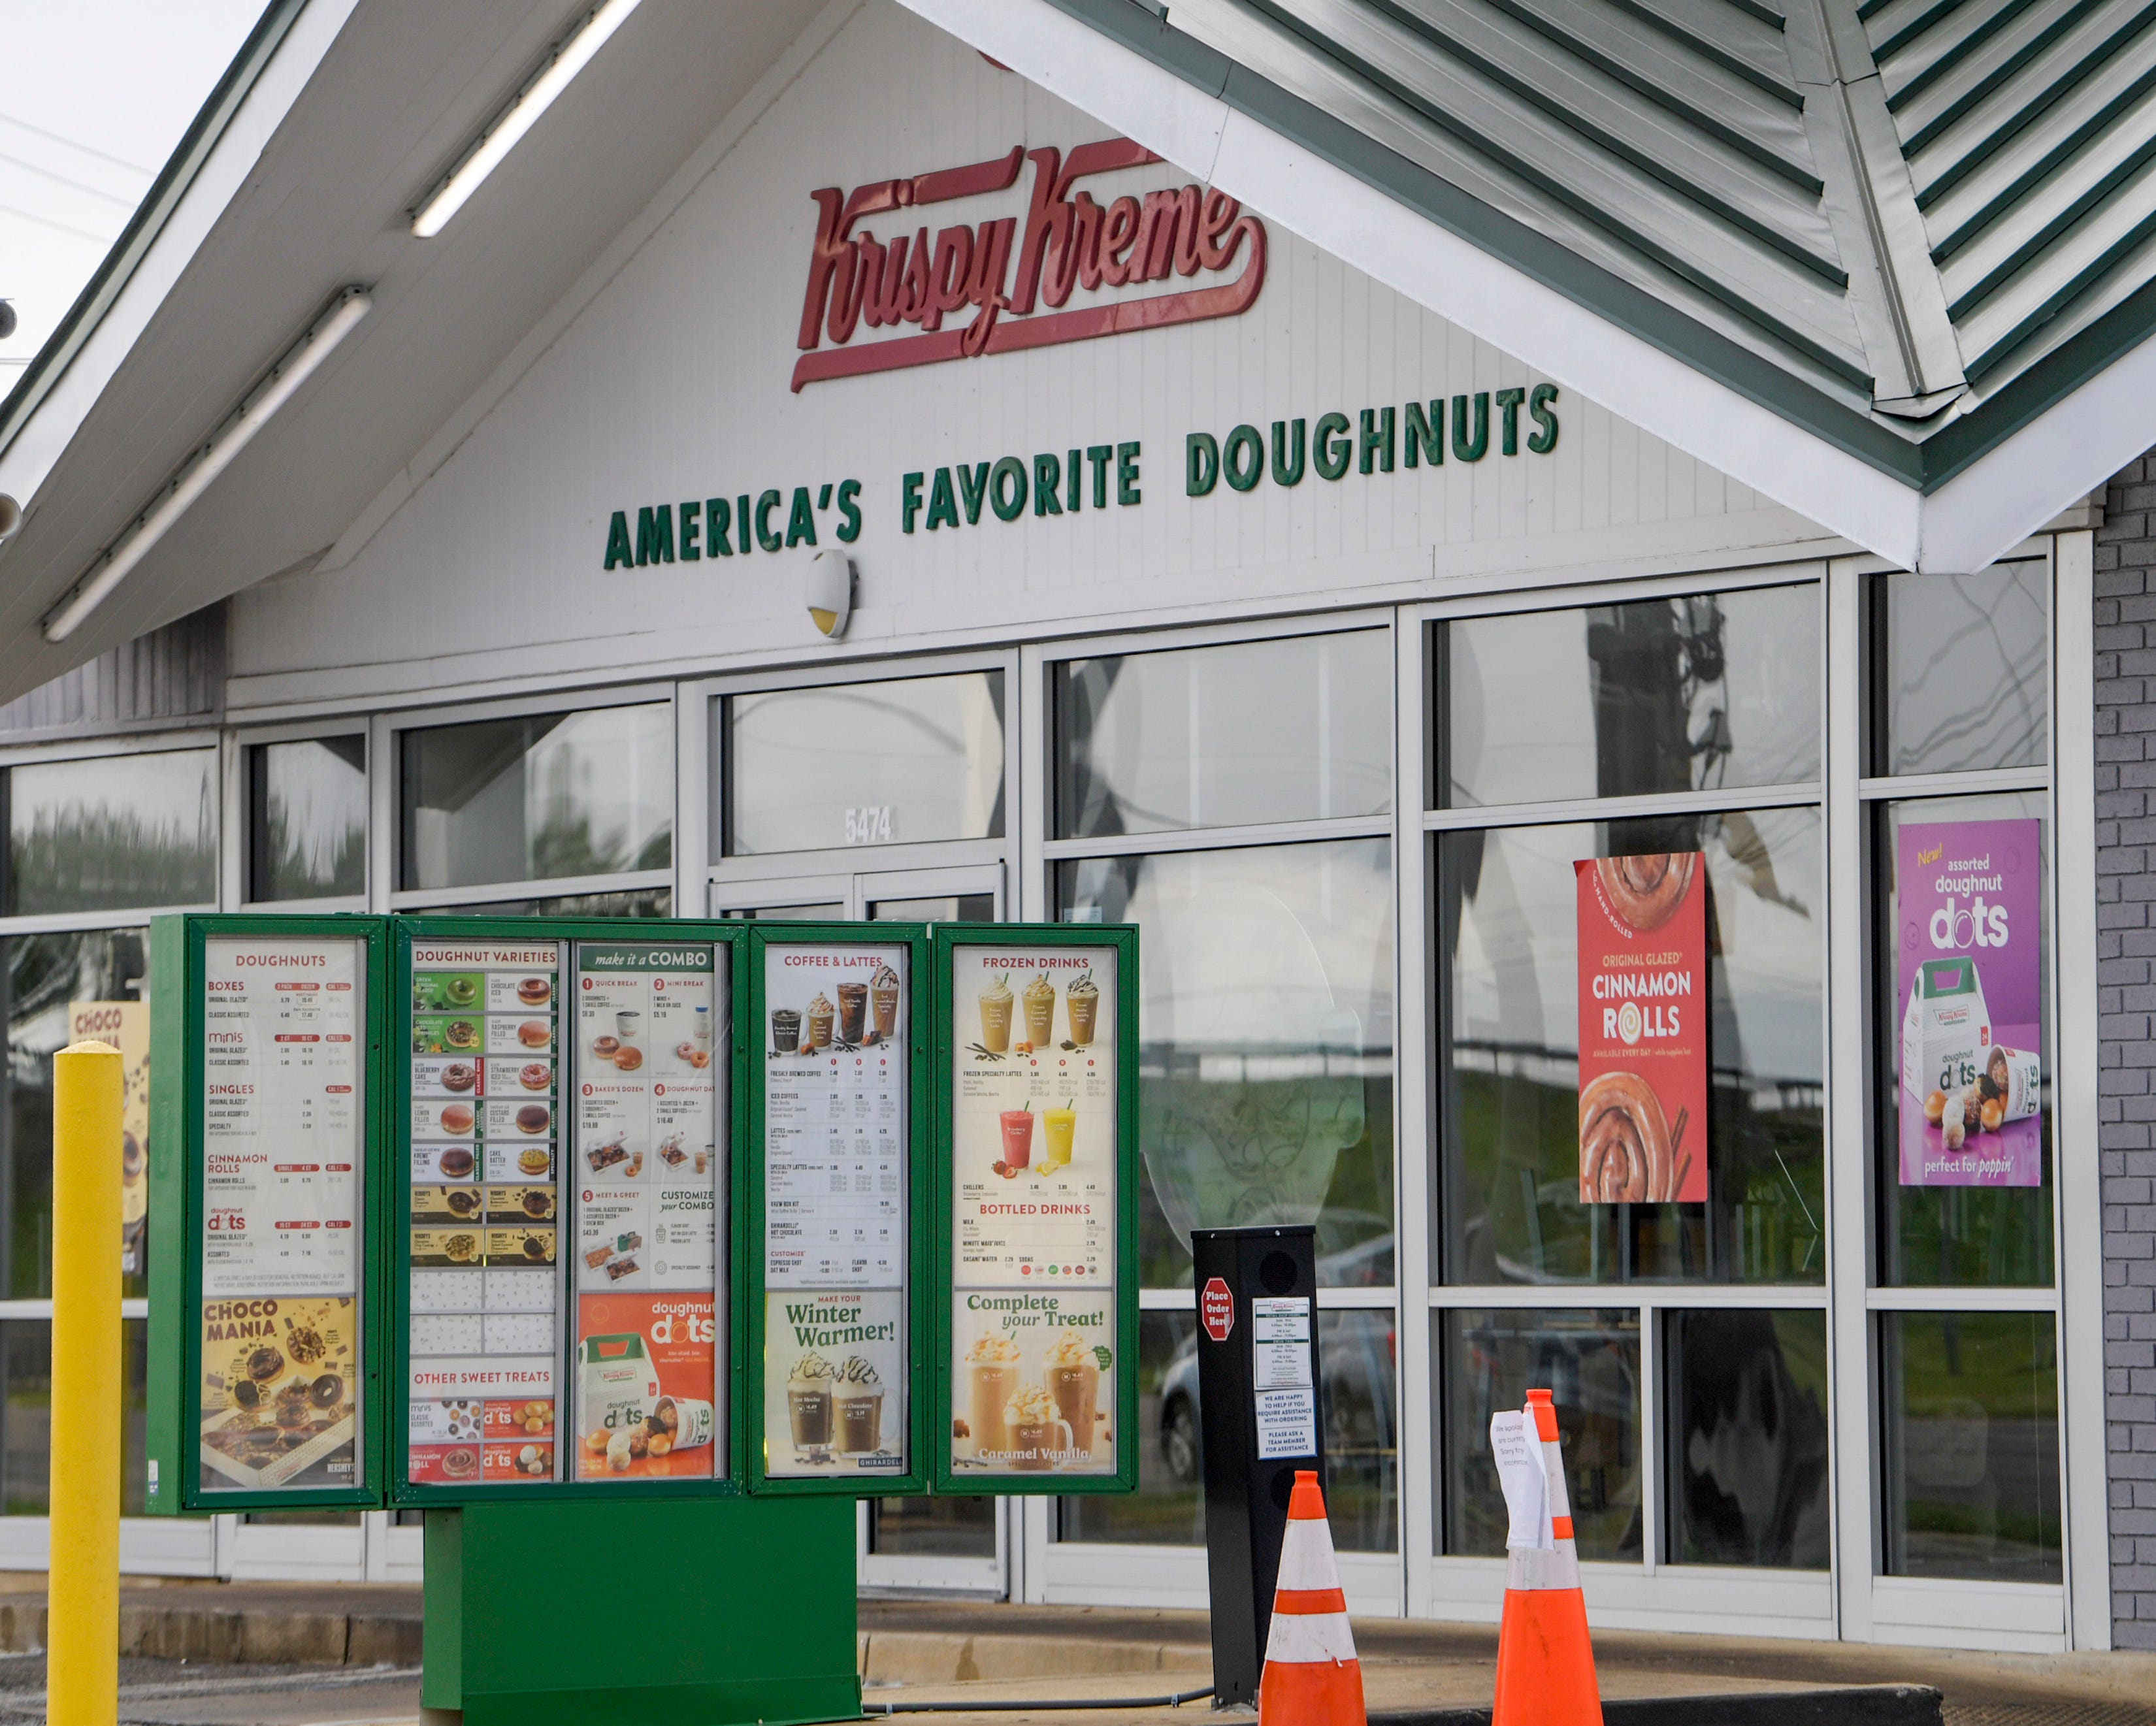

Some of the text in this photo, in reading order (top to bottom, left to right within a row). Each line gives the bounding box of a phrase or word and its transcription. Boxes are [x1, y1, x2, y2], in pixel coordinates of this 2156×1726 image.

[797, 145, 1024, 357] Krispy
[604, 382, 1560, 570] AMERICA'S FAVORITE DOUGHNUTS
[845, 806, 890, 843] 5474
[1918, 842, 1943, 868] New!
[1948, 853, 1989, 871] assorted
[1935, 874, 2002, 898] doughnut
[1595, 887, 1633, 939] HAND-ROLLED
[1930, 896, 2009, 949] dots
[236, 955, 326, 966] DOUGHNUTS
[416, 951, 555, 962] DOUGHNUT VARIETIES
[595, 952, 707, 966] make it a COMBO
[785, 956, 882, 967] COFFEE & LATTES
[983, 958, 1089, 968] FROZEN DRINKS
[1603, 953, 1644, 968] ORIGINAL
[208, 981, 244, 990] BOXES
[1592, 971, 1691, 999] CINNAMON
[76, 1009, 122, 1034] CHOCO
[1603, 1001, 1680, 1045] ROLLS
[209, 1032, 243, 1043] minis
[1593, 1049, 1621, 1058] AVAILABLE
[1622, 1049, 1639, 1057] EVERY
[1641, 1048, 1651, 1056] DAY
[1942, 1049, 1973, 1064] doughnut
[209, 1084, 254, 1094] SINGLES
[208, 1154, 268, 1164] CINNAMON
[208, 1164, 240, 1173] ROLLS
[1925, 1156, 2014, 1179] perfect for poppin'
[661, 1192, 714, 1200] CUSTOMIZE
[210, 1207, 242, 1216] doughnut
[659, 1203, 678, 1213] your
[980, 1205, 1090, 1214] BOTTLED DRINKS
[1206, 1292, 1228, 1301] Place
[204, 1299, 278, 1321] CHOCO
[968, 1294, 1058, 1314] Complete
[1207, 1304, 1229, 1313] Order
[786, 1303, 861, 1324] Winter
[1002, 1311, 1103, 1329] your Treat!
[206, 1320, 276, 1341] MANIA
[794, 1322, 894, 1347] Warmer!
[414, 1371, 549, 1384] OTHER SWEET TREATS
[607, 1399, 640, 1410] doughnut
[979, 1448, 1089, 1459] Caramel Vanilla
